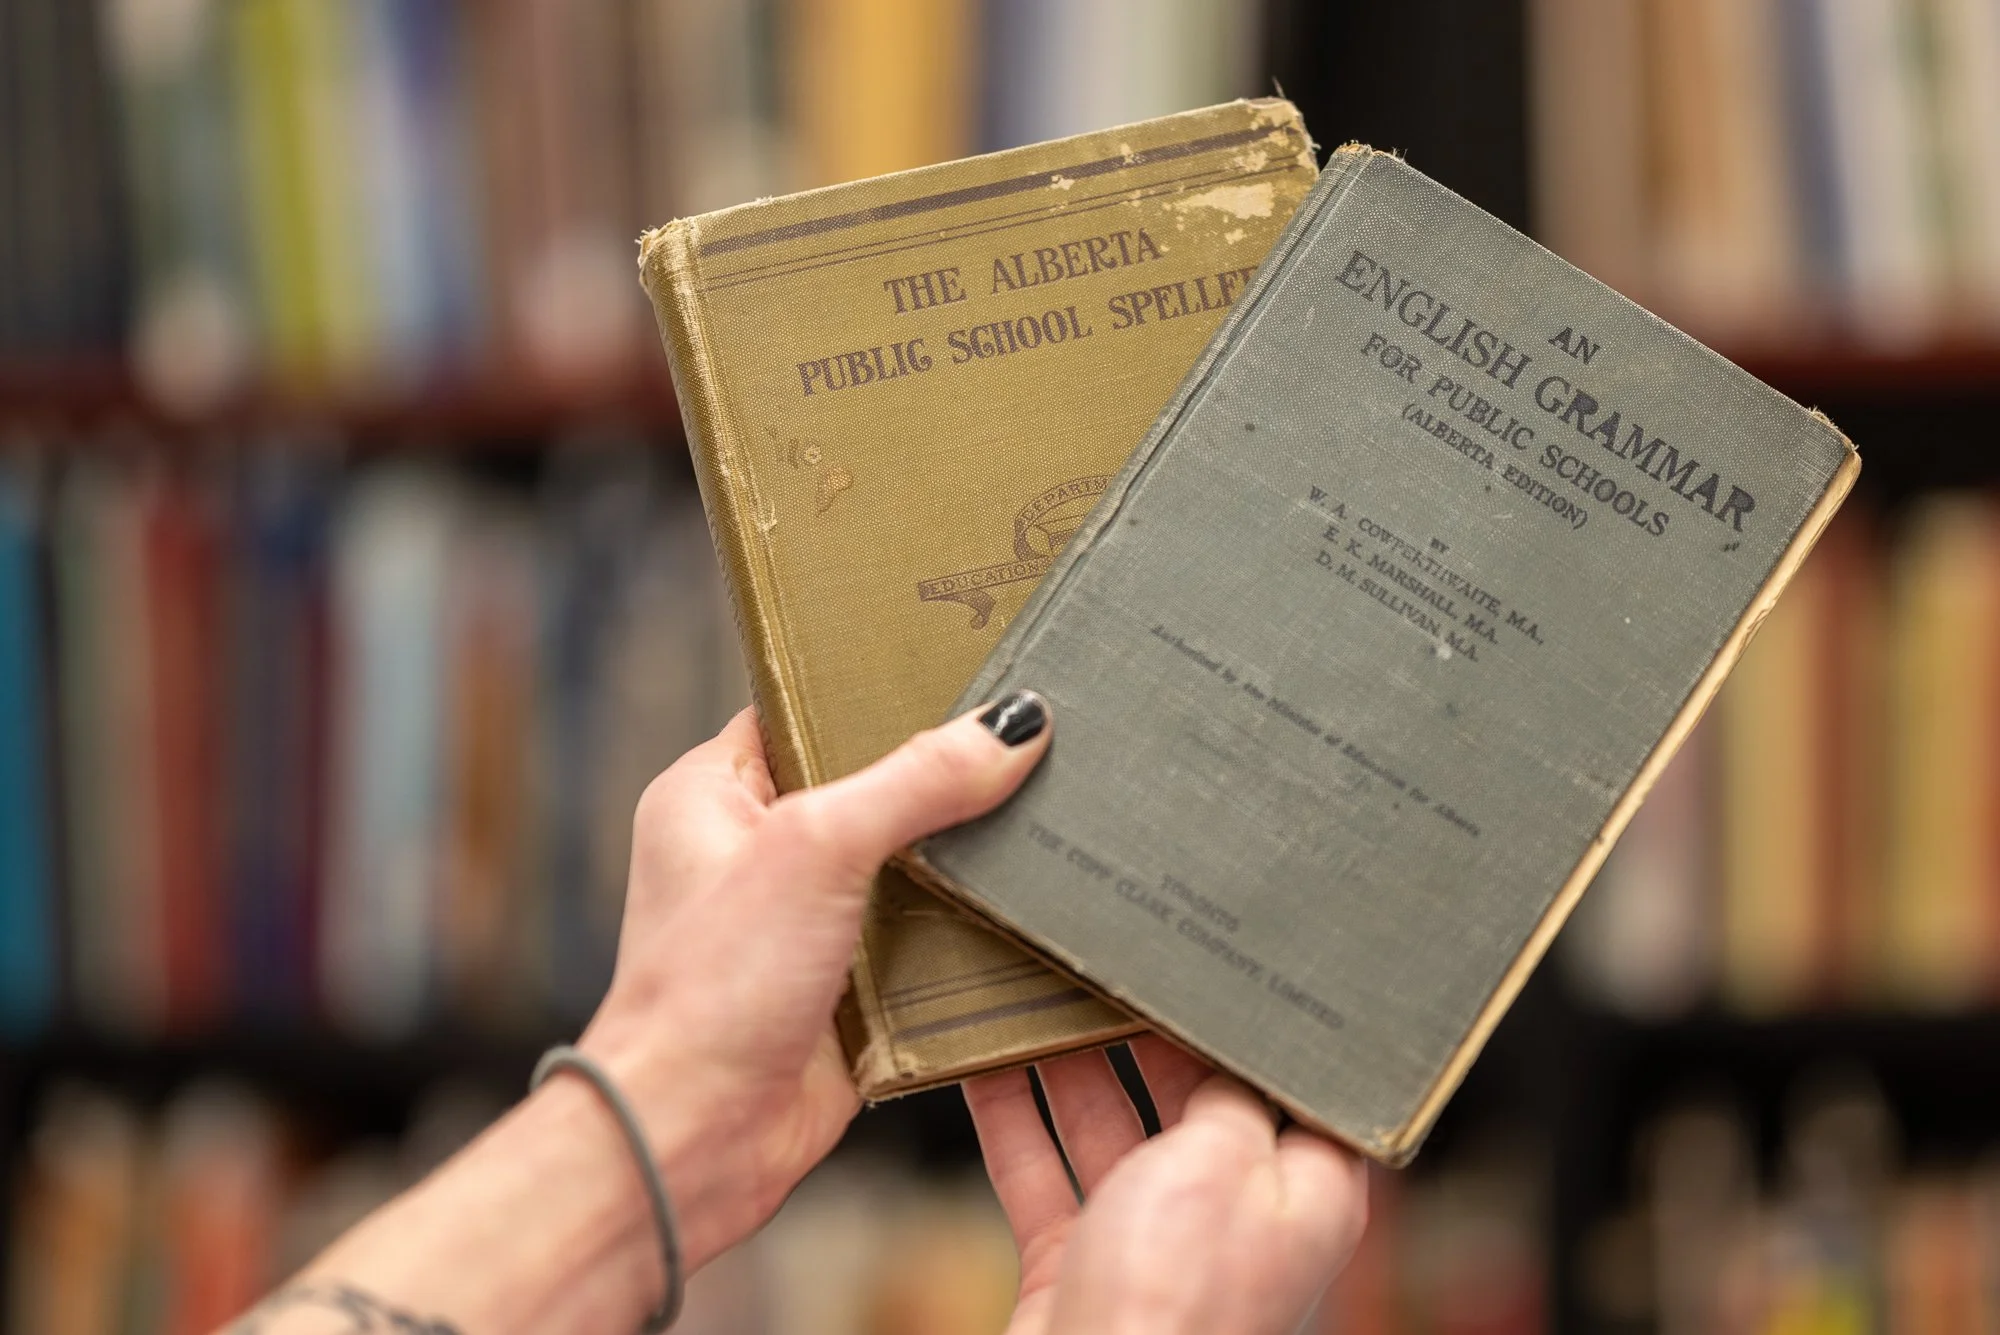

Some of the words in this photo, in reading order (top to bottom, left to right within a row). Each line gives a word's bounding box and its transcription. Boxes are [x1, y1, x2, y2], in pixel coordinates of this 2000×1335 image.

[884, 267, 967, 315] THE
[990, 228, 1165, 295] ALBERTA
[796, 338, 933, 397] PUBLIC
[947, 307, 1094, 365] SCHOOL
[1548, 327, 1601, 365] AN
[1335, 250, 1533, 390] ENGLISH
[1535, 376, 1757, 533] GRAMMAR
[1360, 332, 1423, 385] FOR
[1427, 373, 1535, 451] PUBLIC
[1539, 444, 1671, 538] SCHOOLS
[1309, 485, 1329, 507] W.
[1401, 402, 1495, 470] (ALBERTA
[1501, 464, 1589, 530] EDITION)
[930, 563, 1039, 595] EDUCATION
[1429, 537, 1450, 554] BY
